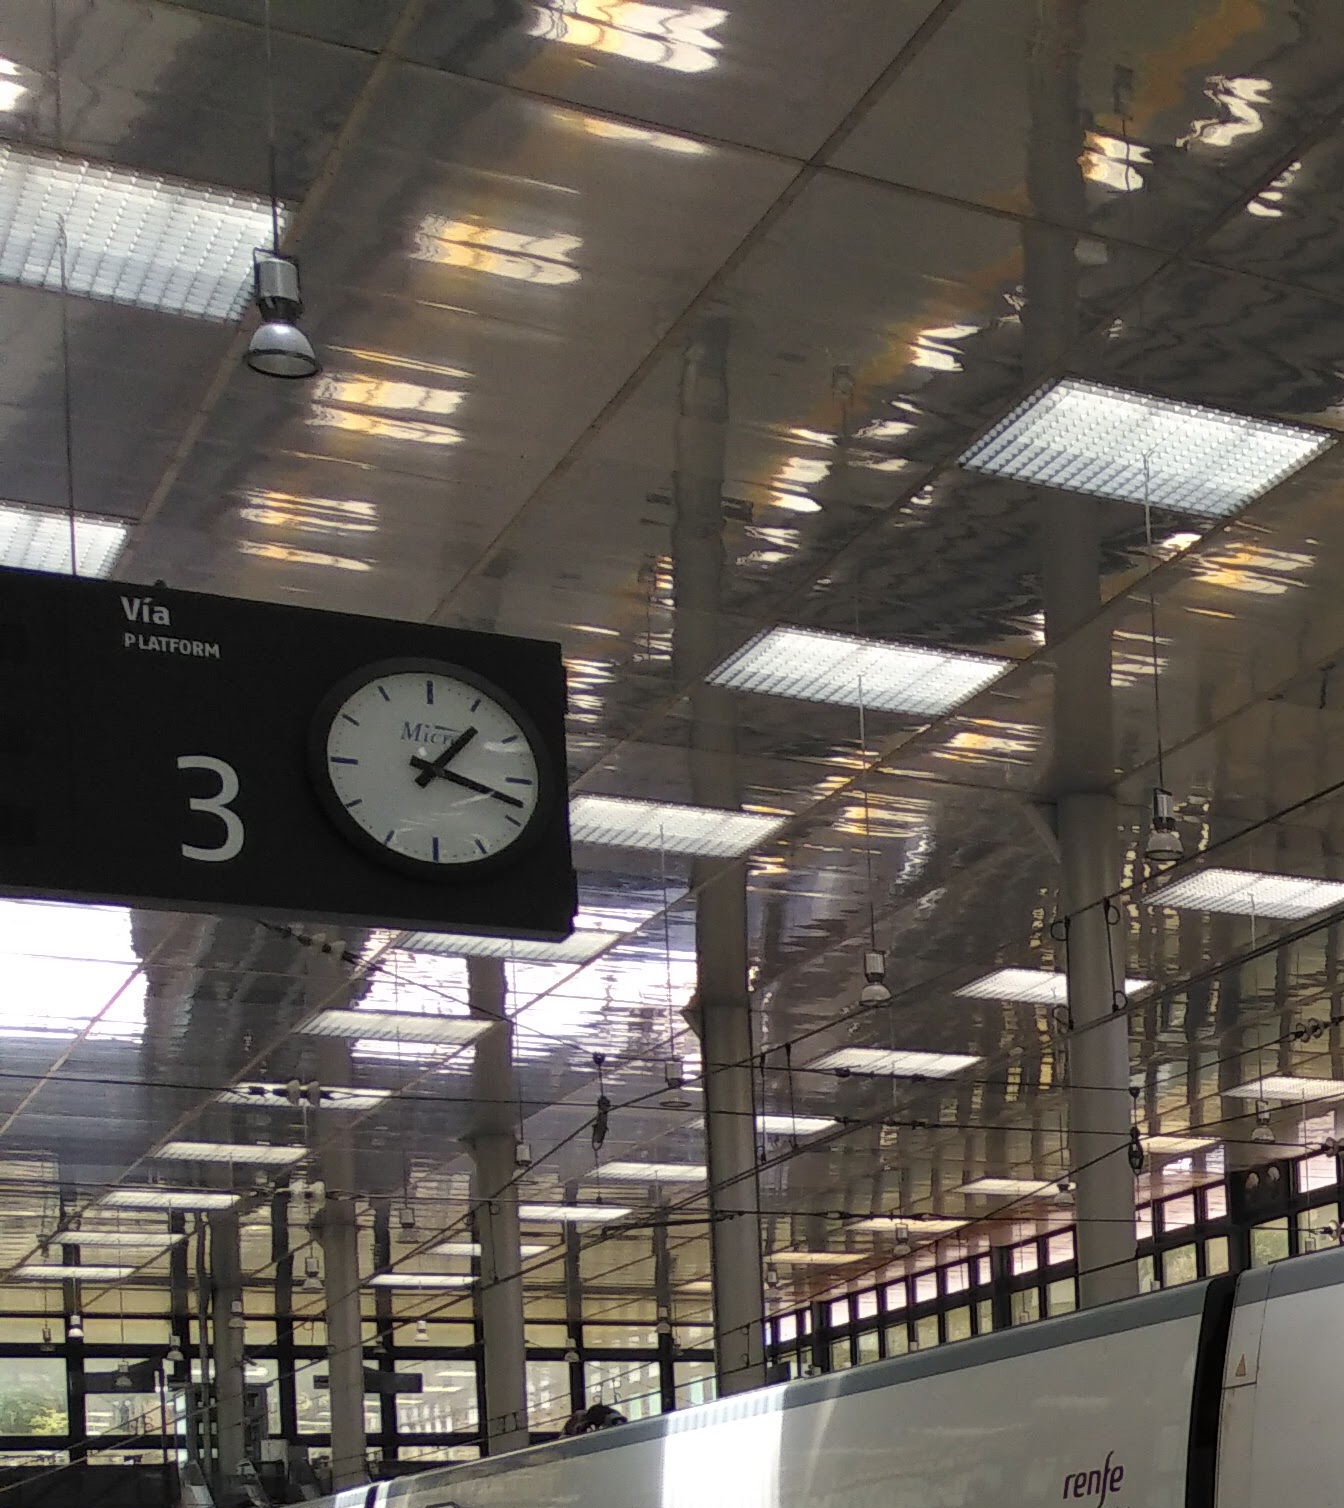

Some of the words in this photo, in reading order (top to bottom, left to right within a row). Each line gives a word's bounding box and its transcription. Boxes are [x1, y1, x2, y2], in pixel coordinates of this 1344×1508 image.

[120, 596, 171, 626] Vía
[124, 631, 221, 659] PLATFORM
[176, 755, 246, 862] 3
